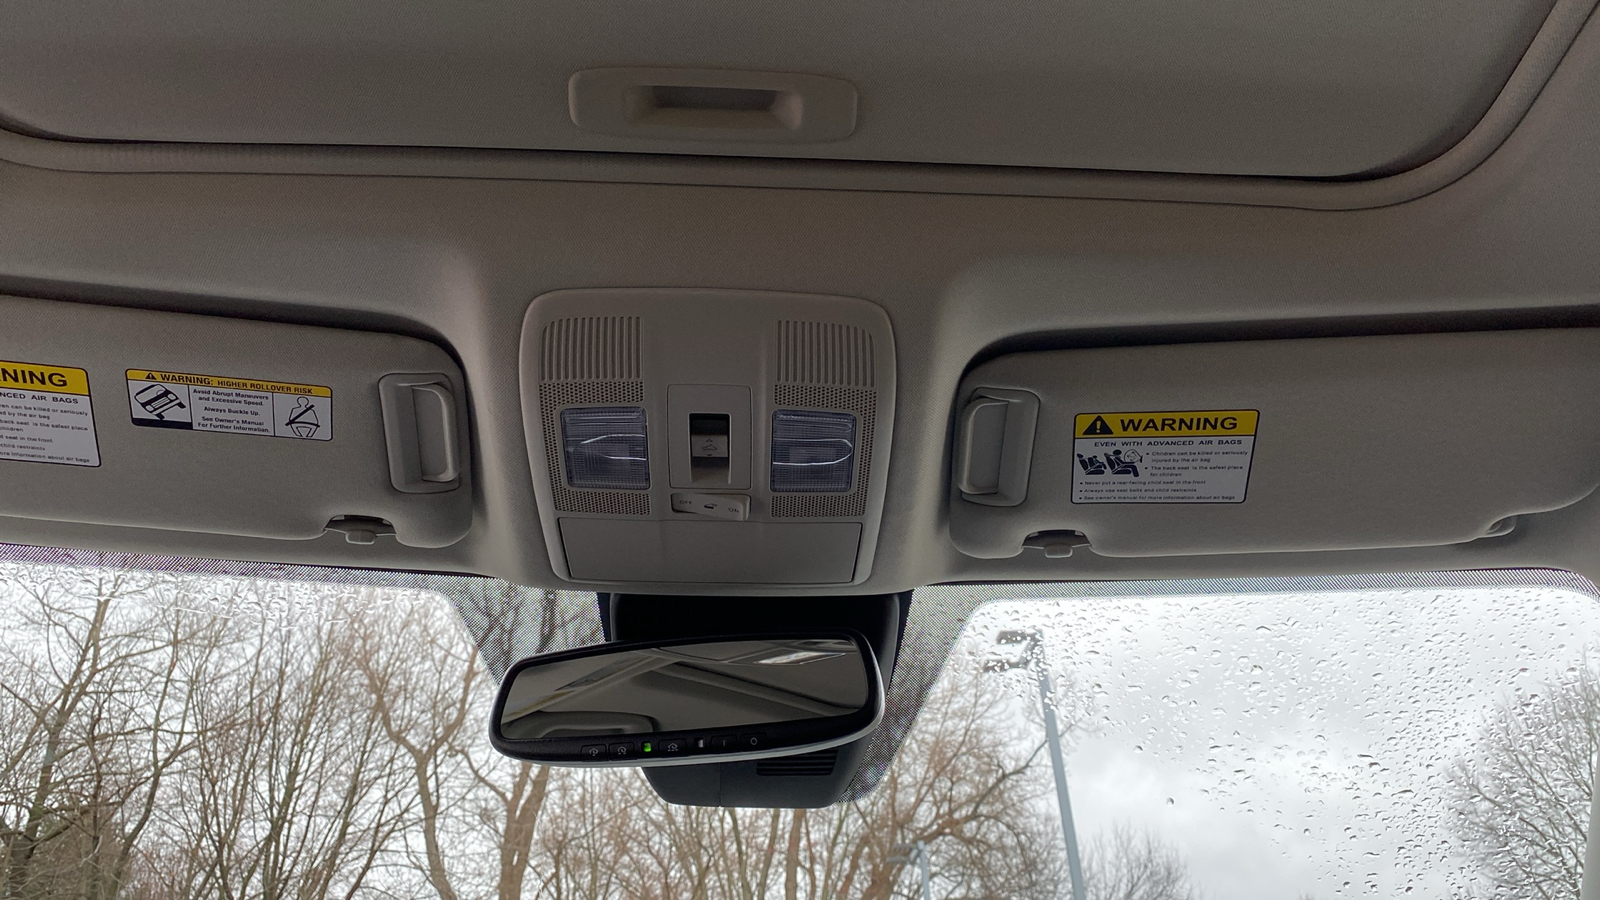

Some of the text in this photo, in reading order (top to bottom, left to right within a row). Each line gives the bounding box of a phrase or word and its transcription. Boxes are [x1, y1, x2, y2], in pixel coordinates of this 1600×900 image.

[0, 367, 68, 387] NING
[160, 374, 313, 395] WARNING: HIGHER ROLLOVER RISK
[0, 391, 26, 399] NCED
[52, 396, 79, 404] BAGS
[192, 388, 269, 401] Avoid Abrupt Maneuvers
[211, 397, 242, 405] Excessive
[203, 406, 227, 414] Always
[227, 408, 249, 416] Buckle
[201, 415, 264, 427] See Owner's Manual
[209, 423, 232, 431] Further
[1119, 416, 1239, 432] WARNING
